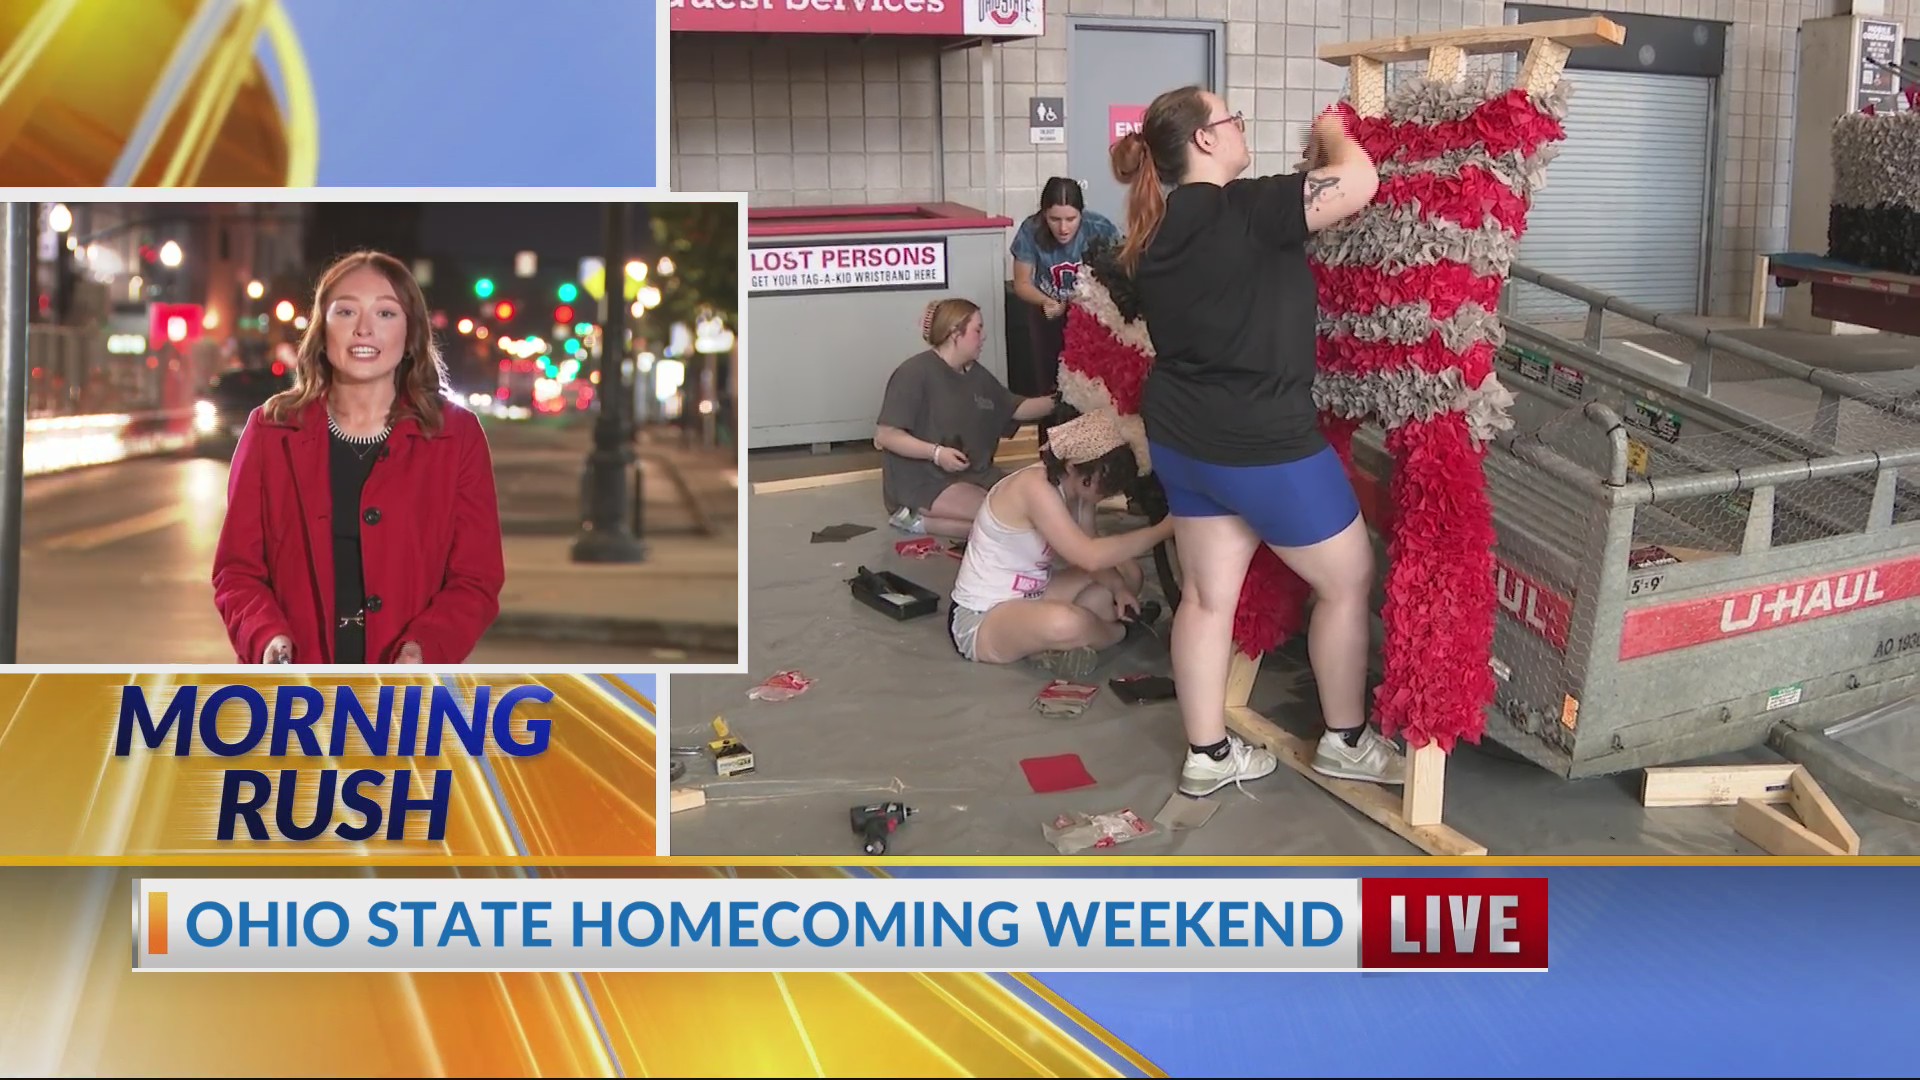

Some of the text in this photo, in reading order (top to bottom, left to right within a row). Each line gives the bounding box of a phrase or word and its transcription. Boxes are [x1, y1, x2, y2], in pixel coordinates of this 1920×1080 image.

[751, 246, 936, 271] LOST PERSONS
[751, 269, 937, 287] GET YOUR TAG-A-KID WRISTBAND HERE
[1720, 568, 1885, 633] U-HAUL
